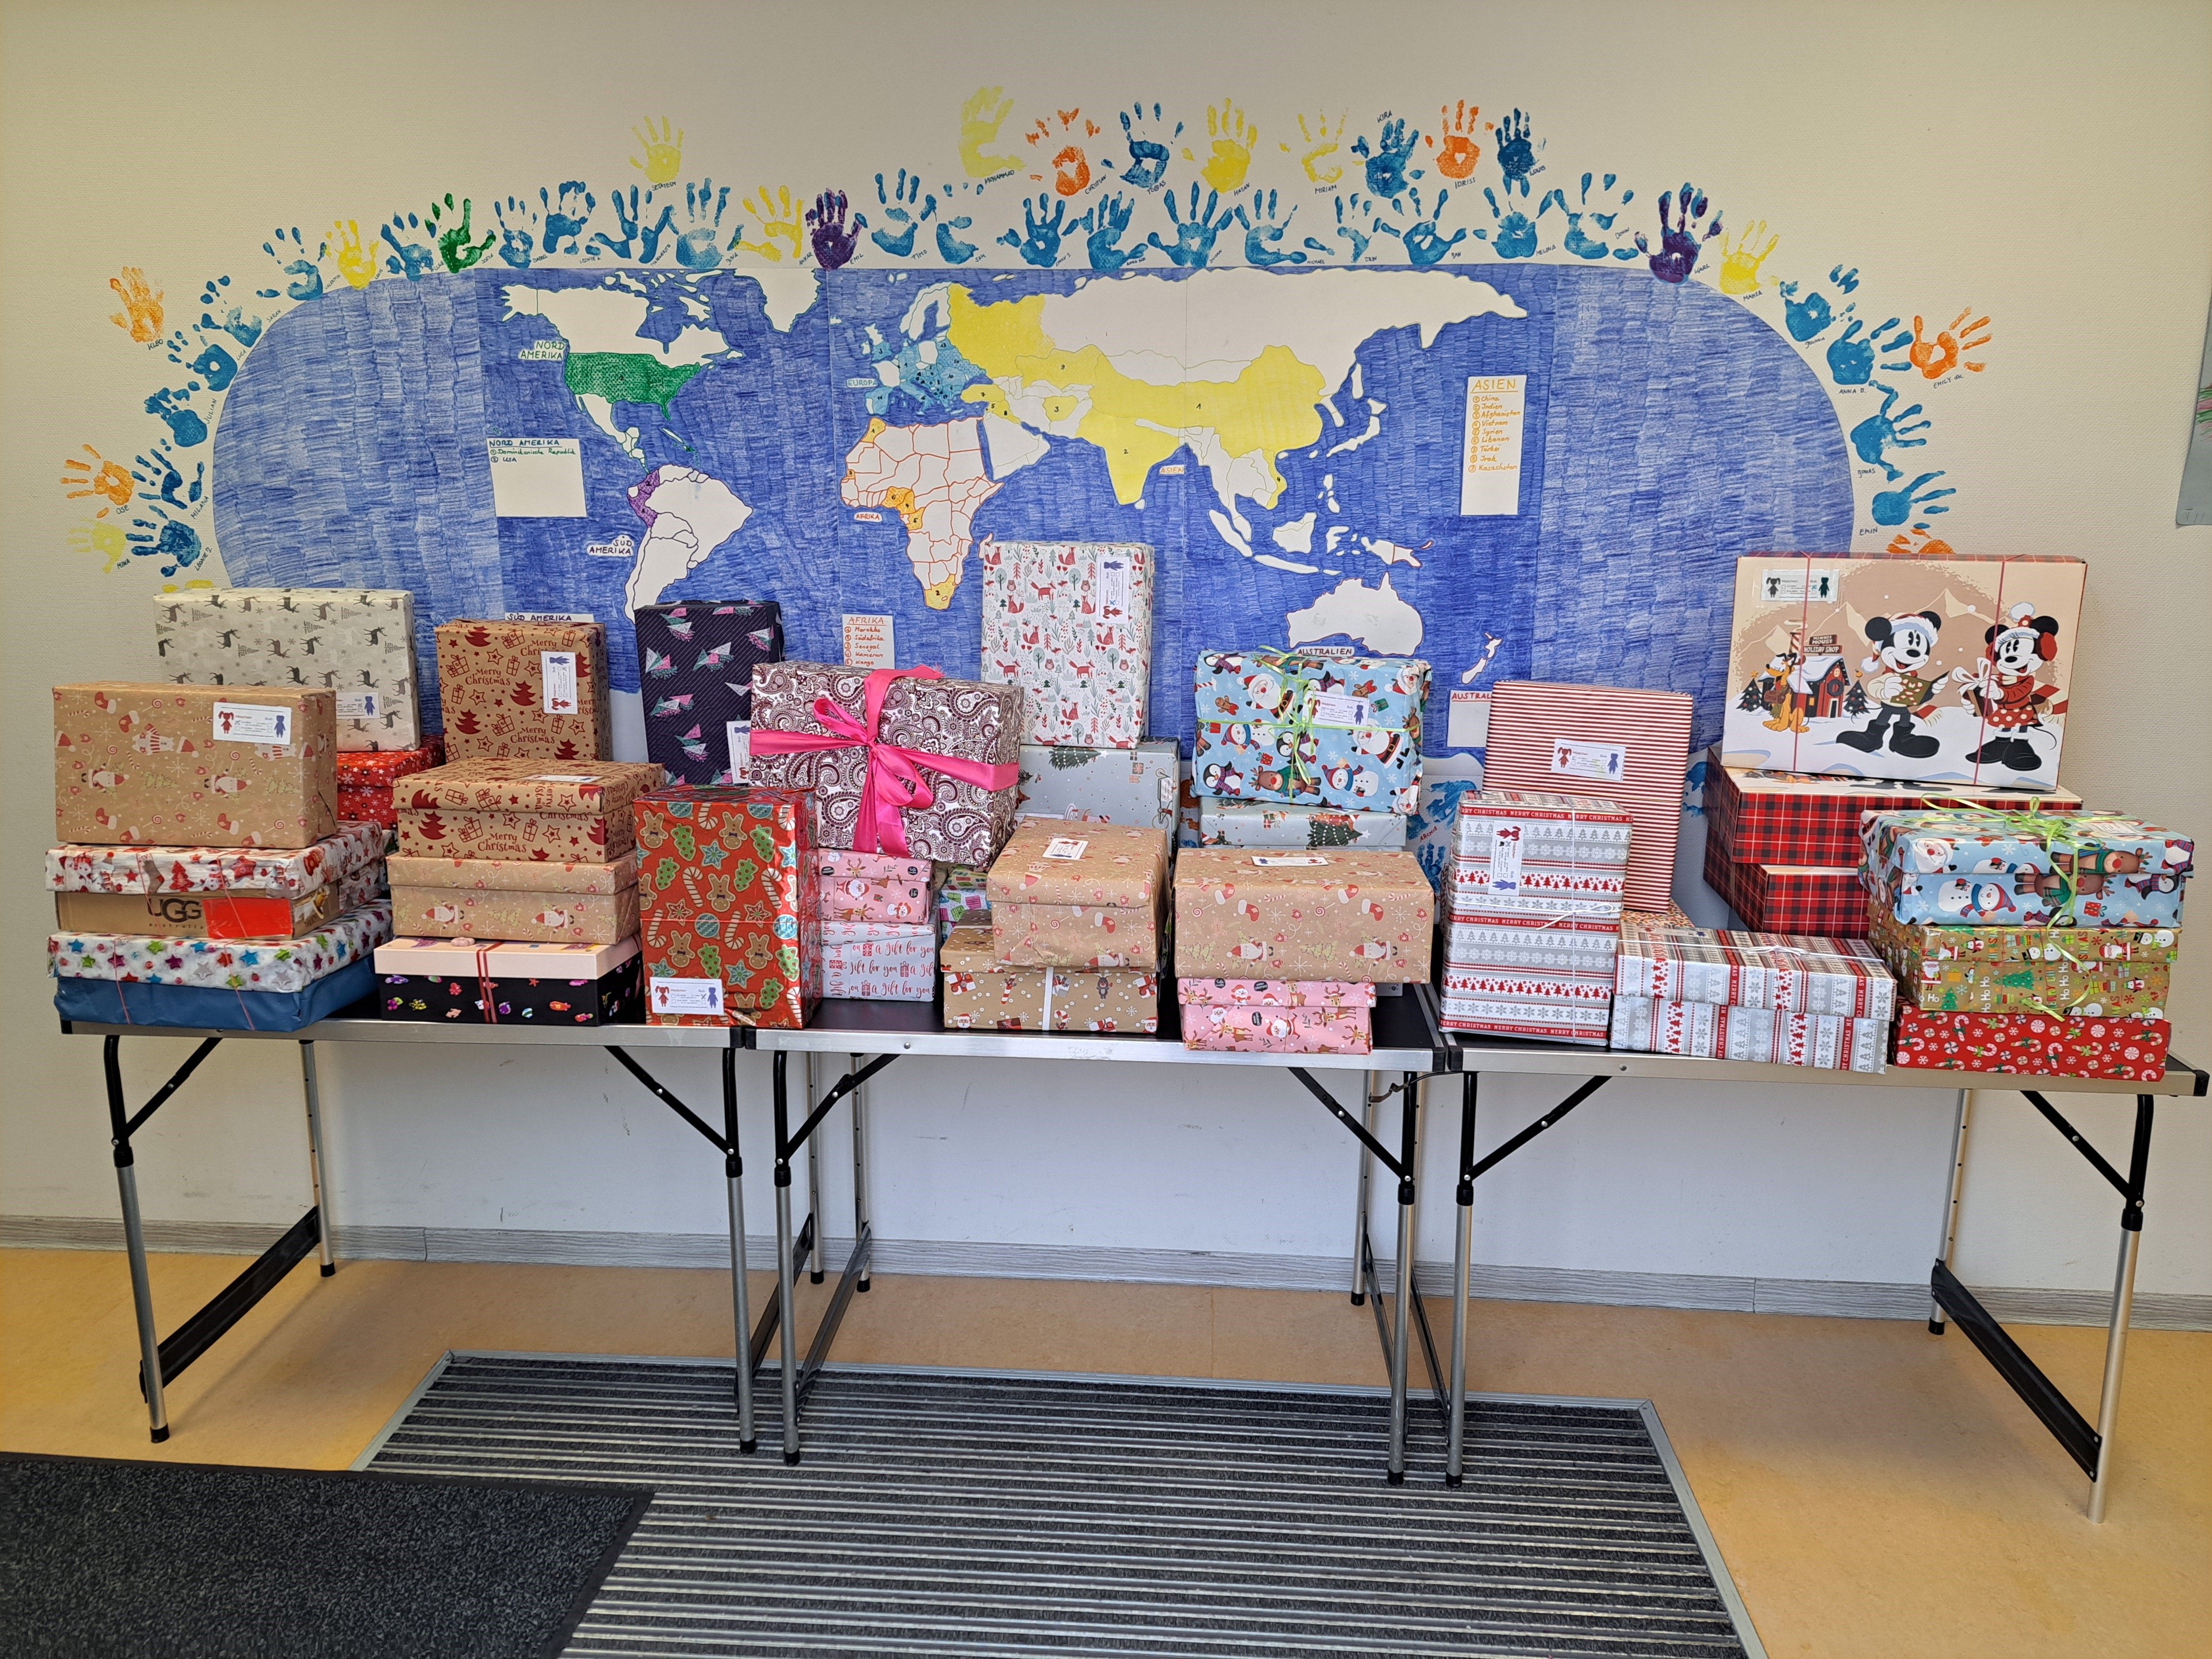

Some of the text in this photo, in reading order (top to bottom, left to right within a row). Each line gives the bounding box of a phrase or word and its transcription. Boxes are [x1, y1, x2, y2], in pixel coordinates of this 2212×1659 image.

[1376, 111, 1393, 123] KIRA
[984, 170, 1015, 185] MOHAMMAD
[1454, 177, 1476, 189] IDRISS
[1147, 180, 1166, 195] TOBIAS
[1233, 183, 1250, 197] HASAN
[1315, 185, 1337, 194] MIRIAM
[850, 253, 864, 265] EMIL
[911, 249, 928, 260] TIMO
[975, 254, 986, 263] SAM
[1694, 264, 1710, 274] KARL
[266, 310, 282, 322] SARAH
[147, 339, 163, 350] KLEO
[536, 341, 565, 350] NORD
[236, 349, 247, 361] LUCA
[520, 351, 563, 360] AMERIKA
[1472, 379, 1516, 392] ASIEN
[1933, 377, 1952, 388] EMILY
[204, 398, 217, 424] JULIAN
[190, 495, 209, 519] MILANA
[589, 546, 631, 555] AMERIKA
[117, 558, 131, 569] MINA
[531, 640, 557, 650] Merry
[854, 643, 880, 652] Senegal
[1297, 647, 1352, 655] AUSTRALIEN
[475, 668, 501, 678] Merry
[465, 674, 511, 686] Christmas
[510, 730, 555, 744] Christmas
[520, 727, 546, 736] Merry
[1473, 808, 1507, 816] CHRISTMAS
[488, 832, 518, 844] Merry
[1419, 826, 1438, 842] ARCHIE
[478, 839, 527, 853] Christmas
[147, 898, 202, 923] UGG
[875, 940, 934, 958] a gift for you
[869, 959, 880, 974] for
[883, 965, 897, 977] you
[910, 965, 917, 975] a
[919, 961, 934, 977] gif
[1980, 976, 1991, 987] Ho
[2058, 962, 2070, 1001] Ho Ho Ho
[872, 984, 878, 995] a
[881, 981, 898, 996] gift
[902, 981, 913, 995] for
[916, 986, 930, 999] you
[1980, 989, 1991, 1001] Ho
[1856, 989, 1864, 1008] MERRY
[1927, 994, 1940, 1003] Ho
[1458, 1021, 1492, 1029] CHRISTMAS
[1718, 1016, 1726, 1049] CHRISTMAS
[1843, 1029, 1851, 1062] CHRISTMAS
